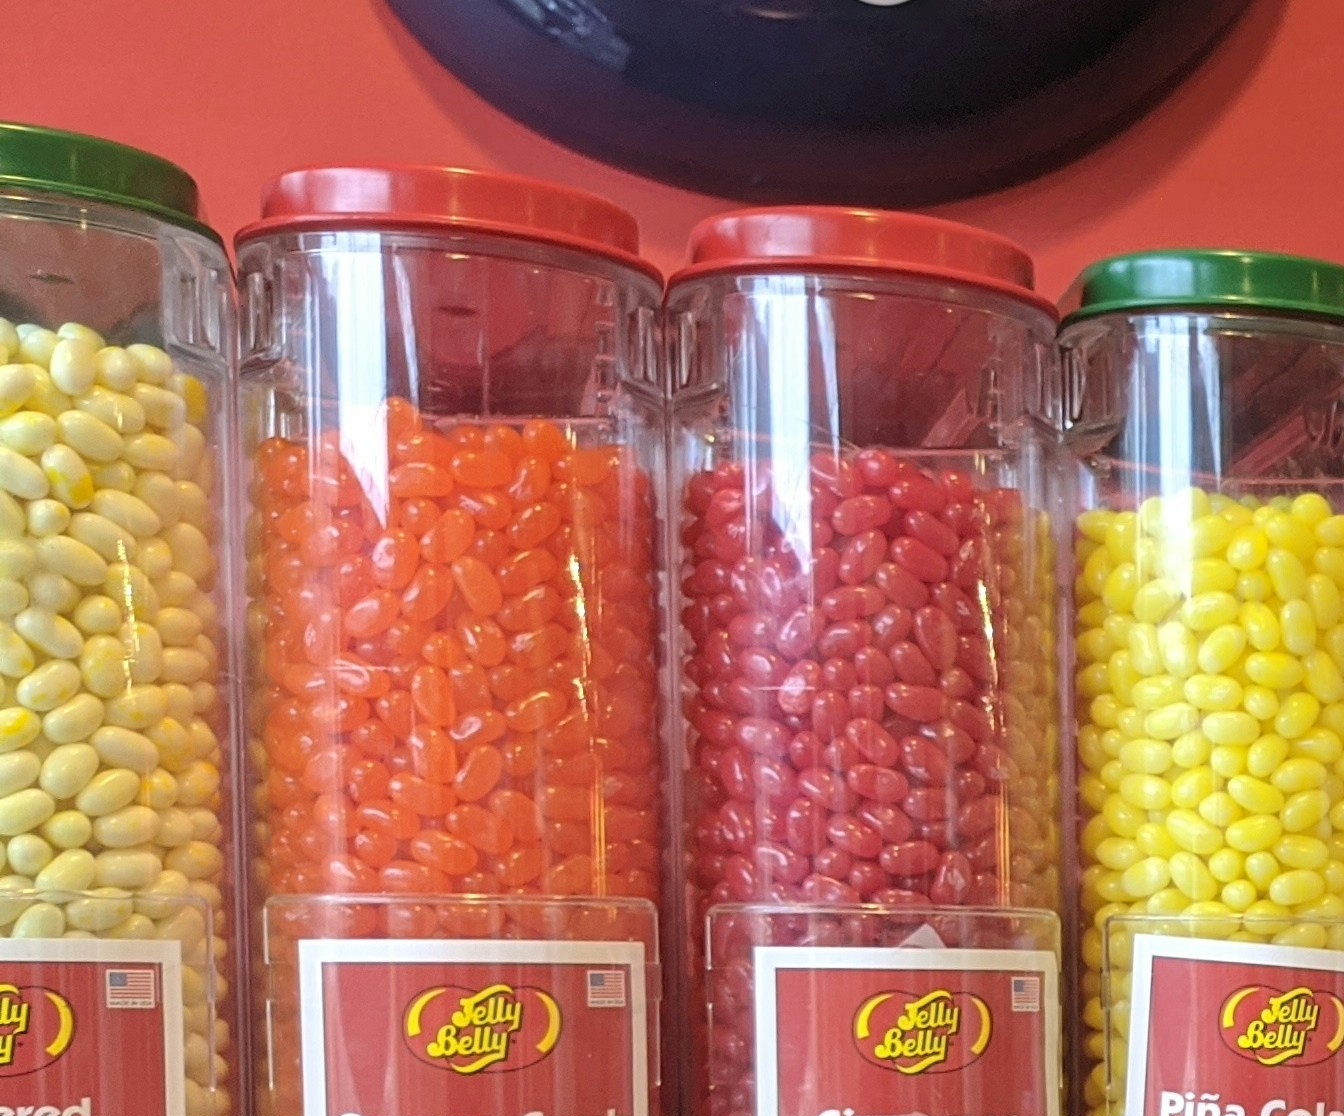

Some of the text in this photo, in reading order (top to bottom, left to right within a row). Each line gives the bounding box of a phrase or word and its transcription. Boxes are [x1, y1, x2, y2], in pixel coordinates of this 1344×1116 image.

[452, 984, 521, 1032] Jelly
[898, 989, 958, 1034] Jelly
[1261, 987, 1318, 1030] Jelly
[427, 1025, 507, 1073] Belly
[874, 1028, 947, 1074] Belly
[1237, 1020, 1307, 1066] Belly
